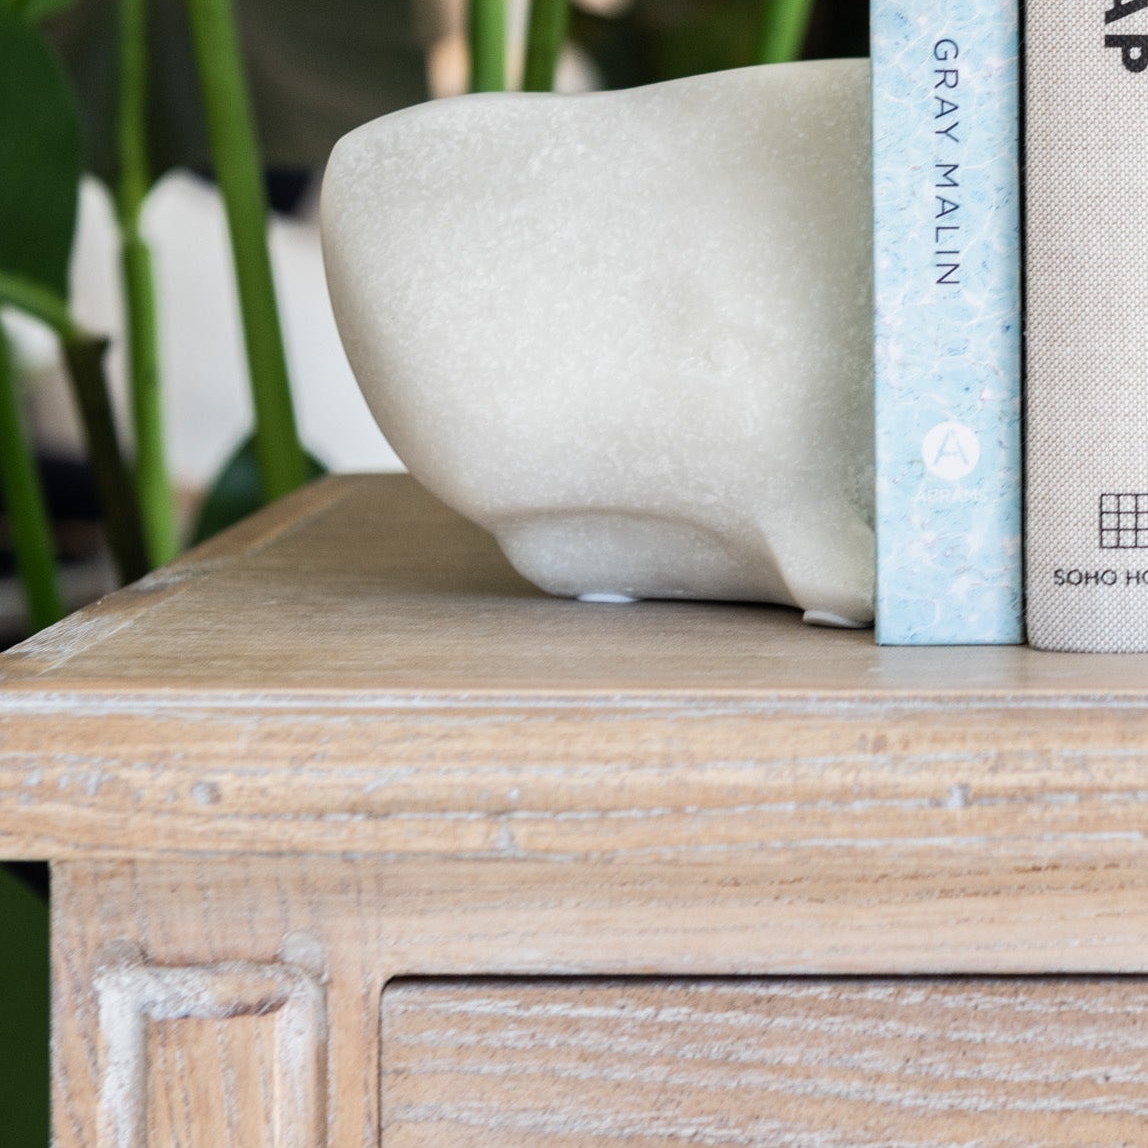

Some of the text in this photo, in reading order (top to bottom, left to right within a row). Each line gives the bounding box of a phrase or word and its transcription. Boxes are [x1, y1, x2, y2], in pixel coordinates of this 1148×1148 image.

[932, 38, 961, 286] GRAY MALIN
[932, 428, 969, 466] A
[913, 487, 989, 503] ABRAMS
[1053, 568, 1117, 587] SOHO
